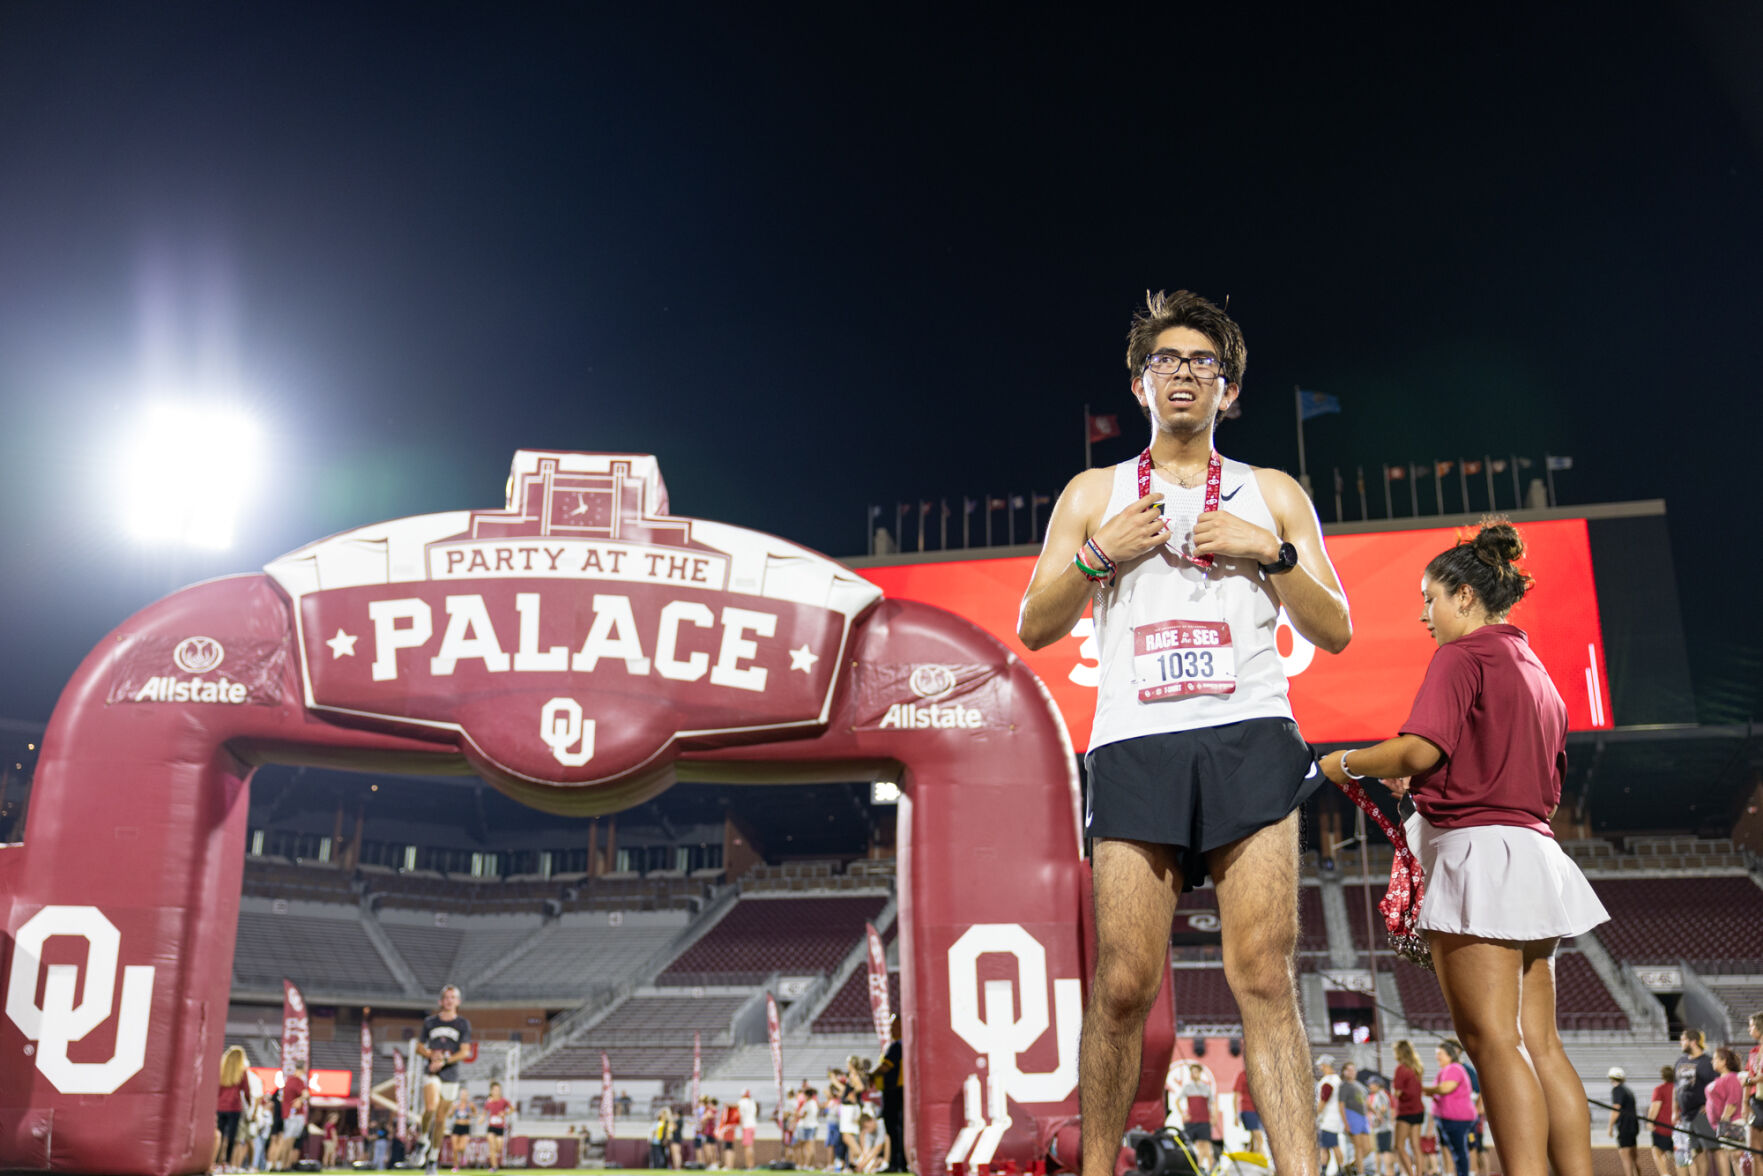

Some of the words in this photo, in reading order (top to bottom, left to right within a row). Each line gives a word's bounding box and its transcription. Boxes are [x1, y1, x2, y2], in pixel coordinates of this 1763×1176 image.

[446, 548, 565, 573] PARTY
[581, 549, 627, 573] AT
[645, 553, 709, 582] THE
[368, 593, 778, 692] PALACE
[1145, 629, 1180, 651] RACE
[1192, 628, 1220, 646] SEC
[1156, 650, 1215, 682] 1033
[134, 676, 248, 704] Allstate
[540, 697, 596, 766] OU
[878, 701, 983, 729] Allstate
[5, 905, 156, 1094] OU
